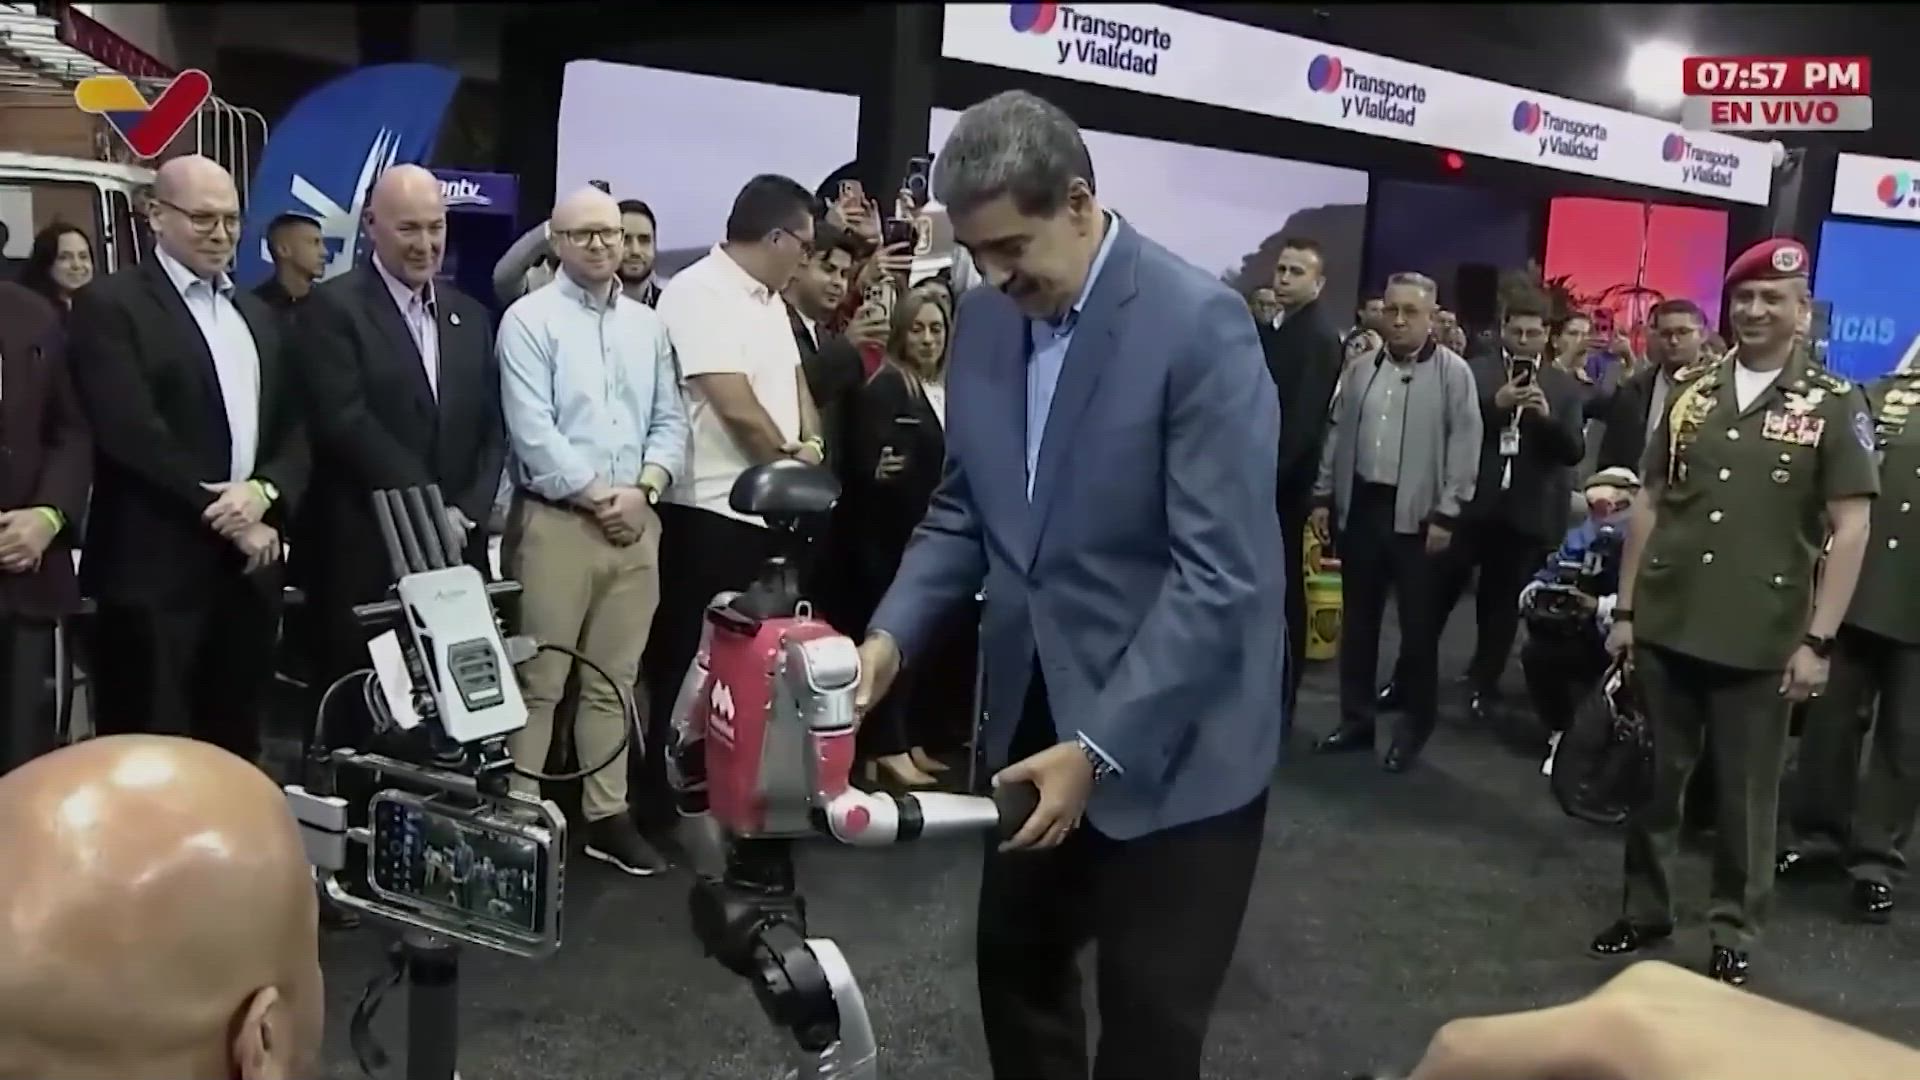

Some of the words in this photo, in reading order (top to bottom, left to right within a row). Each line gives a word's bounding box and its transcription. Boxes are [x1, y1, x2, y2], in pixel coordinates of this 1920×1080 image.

[1060, 6, 1171, 49] Transporte
[1057, 40, 1072, 64] y
[1076, 39, 1158, 76] Vialidad
[1343, 67, 1426, 103] Transporte
[1341, 96, 1352, 118] y
[1354, 94, 1416, 127] Vialidad
[1539, 137, 1547, 156] y
[1549, 135, 1598, 160] Vialidad
[438, 178, 480, 197] antv
[1682, 166, 1690, 183] y
[1832, 315, 1896, 345] ICAS
